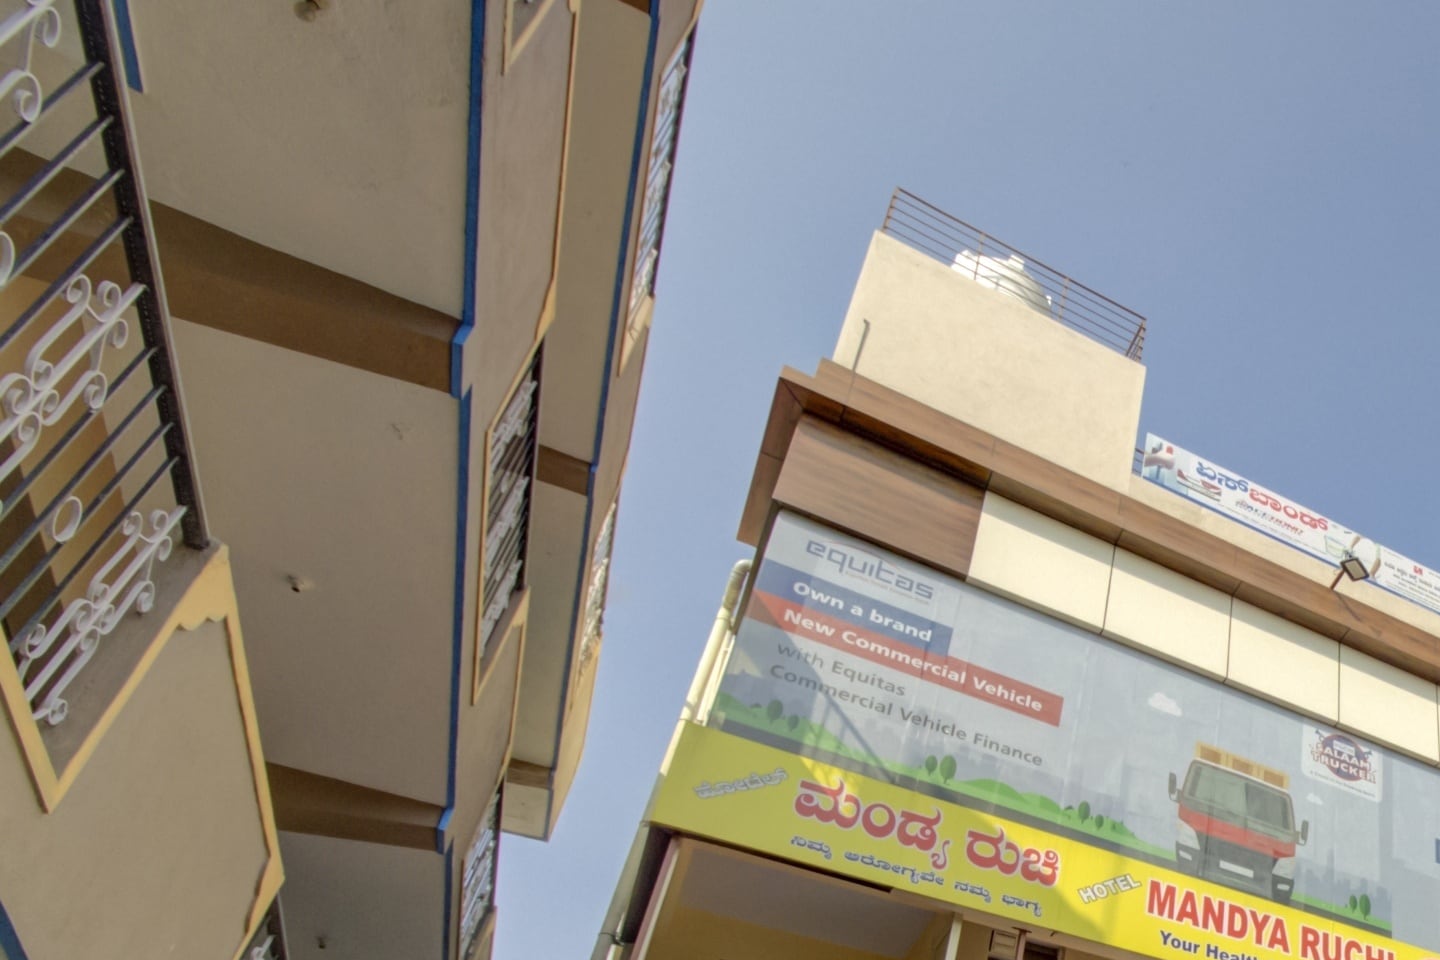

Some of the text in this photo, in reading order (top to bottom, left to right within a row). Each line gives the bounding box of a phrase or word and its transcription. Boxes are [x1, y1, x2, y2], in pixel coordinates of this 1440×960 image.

[806, 539, 935, 600] equitas
[793, 582, 844, 611] Own
[851, 602, 863, 617] a
[871, 608, 932, 643] brand
[777, 643, 905, 696] with Equitas
[784, 609, 1042, 712] New Commercial Vehicle
[770, 664, 1043, 767] Commercial Vehicle Finance
[795, 776, 1060, 887] ಮಂಡ್ಯ ರುಚಿ
[1078, 873, 1142, 904] HOTEL
[1147, 879, 1290, 953] MANDYA
[1160, 930, 1200, 954] Your
